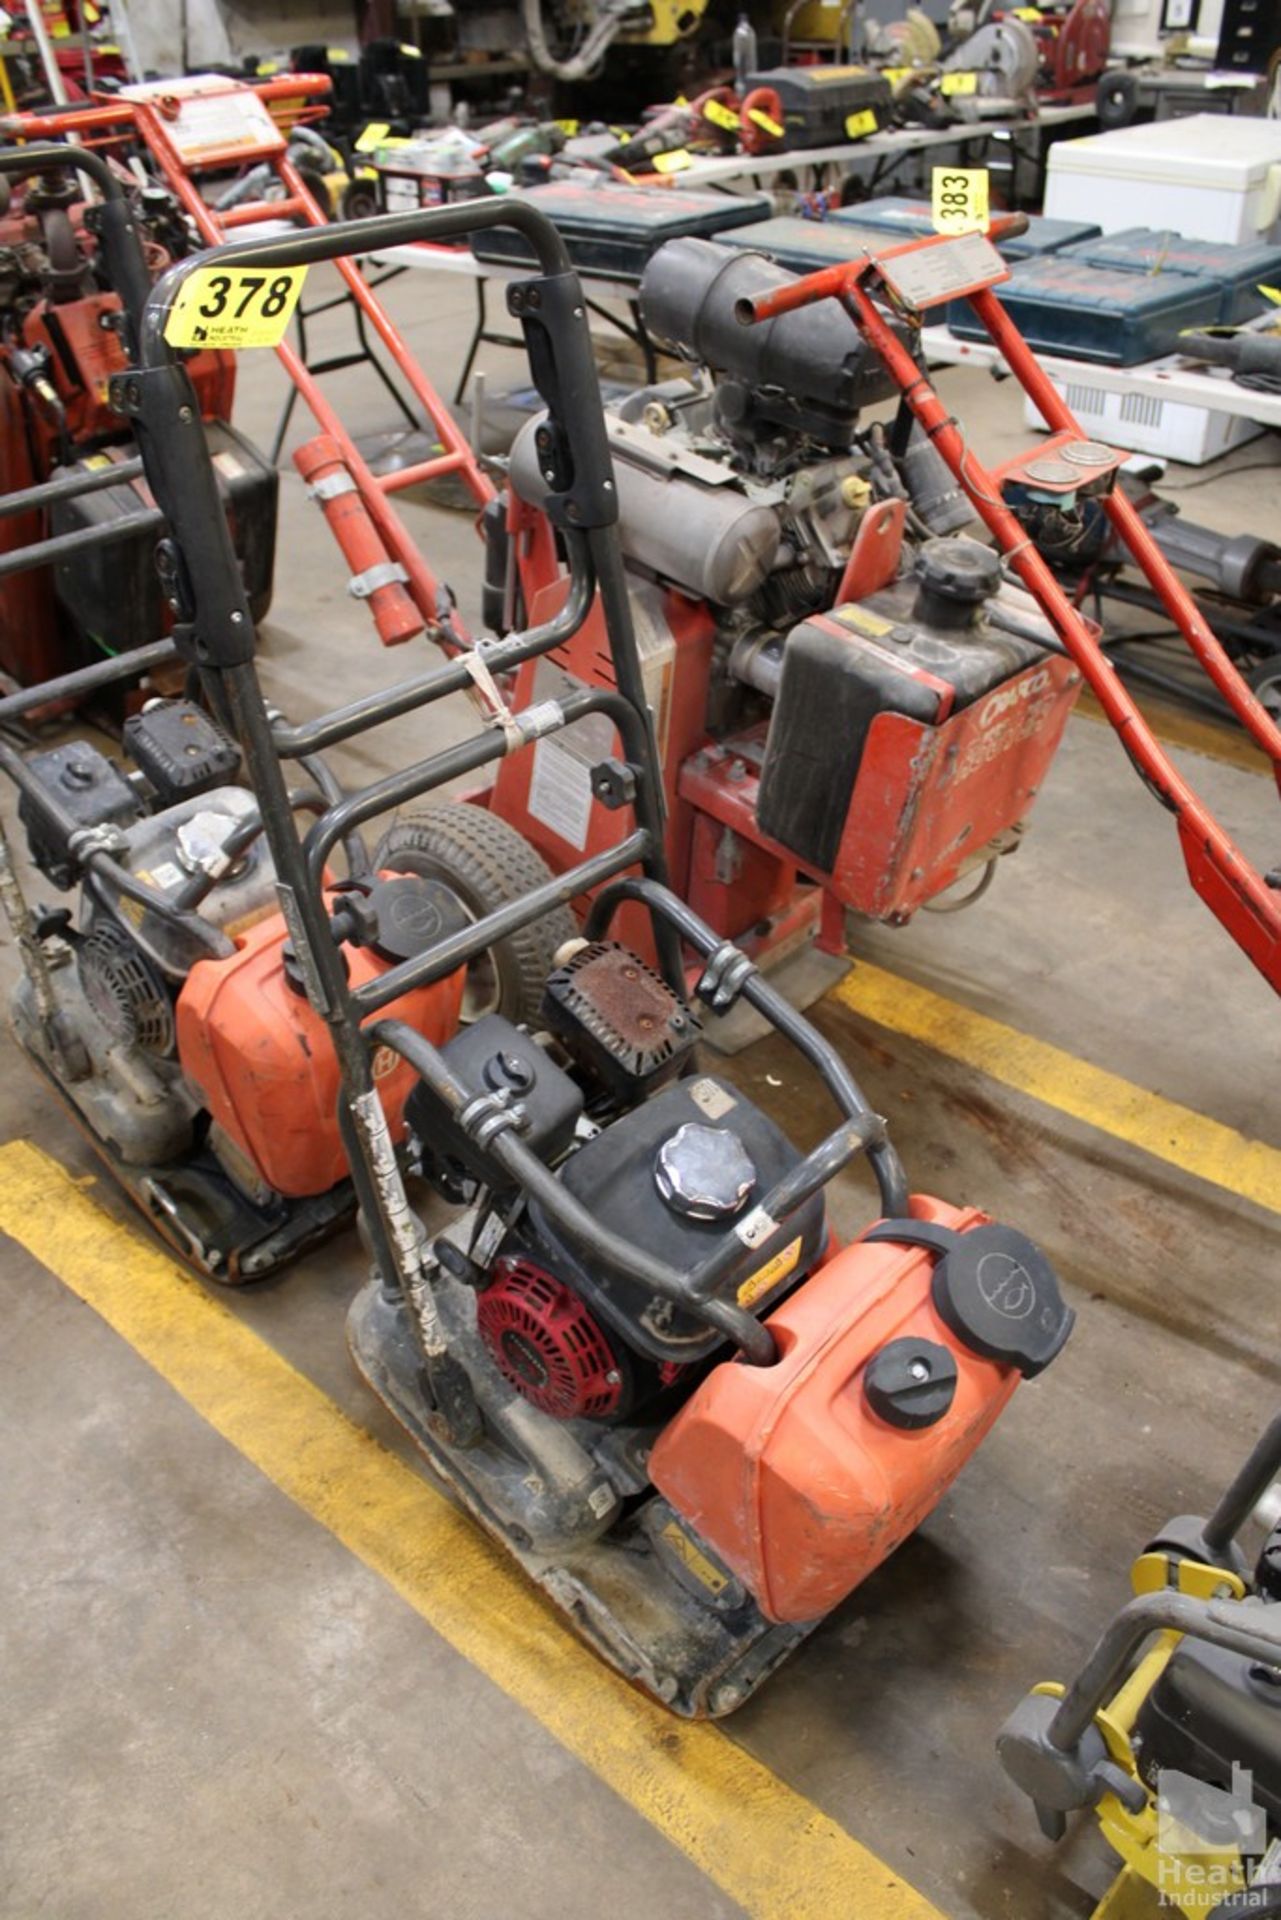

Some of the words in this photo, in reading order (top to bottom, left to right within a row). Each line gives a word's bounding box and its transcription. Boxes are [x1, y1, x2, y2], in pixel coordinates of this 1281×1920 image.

[940, 175, 969, 219] 383
[200, 276, 293, 318] 378
[210, 326, 249, 334] HEATH
